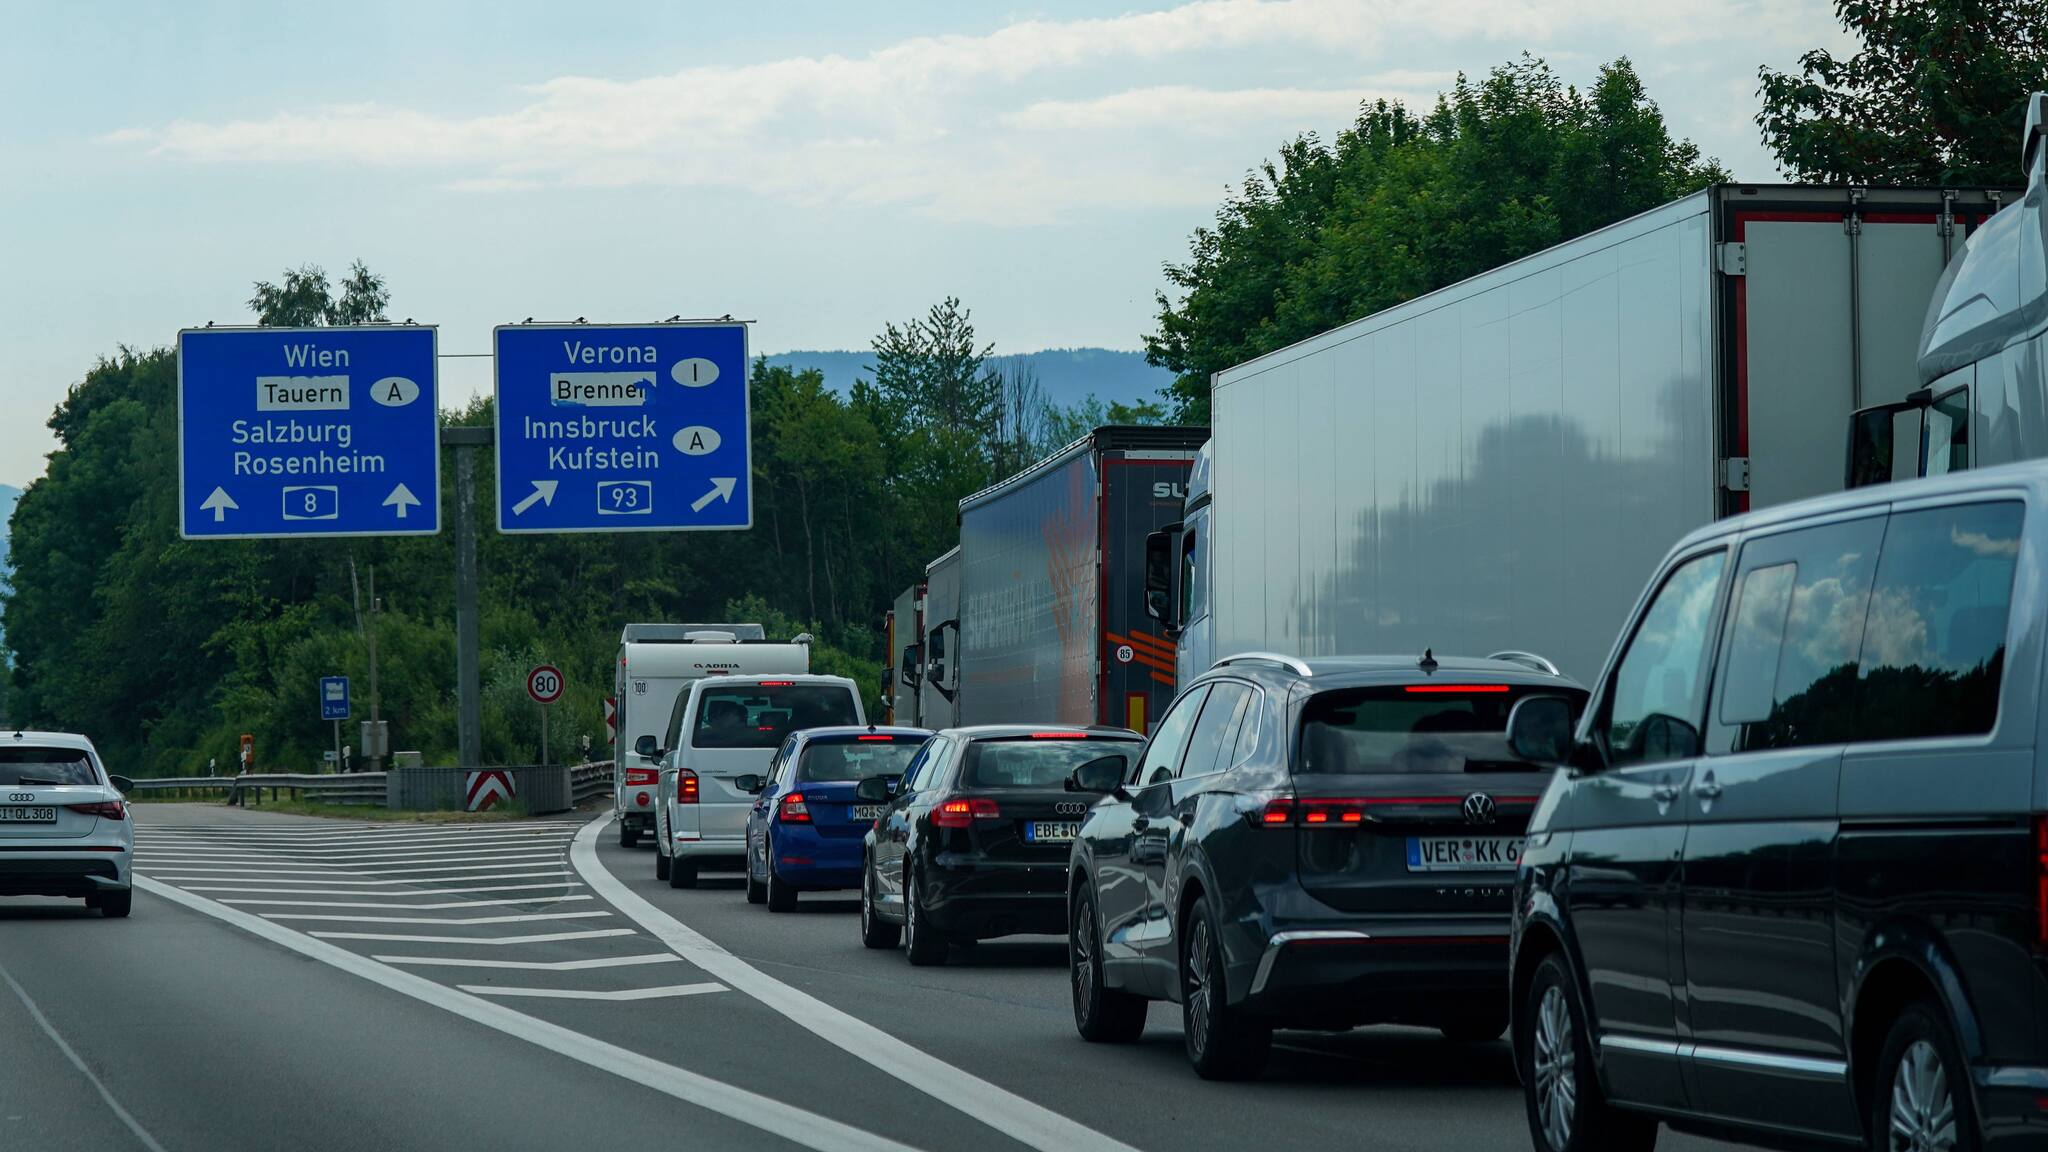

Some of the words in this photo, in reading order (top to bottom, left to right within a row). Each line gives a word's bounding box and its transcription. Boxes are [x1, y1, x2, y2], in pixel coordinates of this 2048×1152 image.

[283, 344, 349, 367] Wien
[564, 341, 657, 364] Verona
[692, 363, 698, 382] I
[264, 383, 342, 403] Tauern
[387, 382, 403, 401] A
[231, 419, 351, 448] Salzburg
[524, 414, 657, 439] Innsbruck
[688, 431, 705, 450] A
[233, 450, 385, 475] Rosenheim
[549, 446, 660, 469] Kufstein
[303, 493, 317, 512] 8
[611, 488, 638, 507] 93
[1119, 648, 1130, 659] 85
[535, 676, 556, 693] 80
[634, 682, 646, 693] 100
[325, 706, 330, 715] 2
[333, 704, 347, 714] km
[15, 808, 31, 819] QL
[32, 808, 54, 819] 308
[854, 806, 869, 818] MQ
[1034, 823, 1061, 838] EBE
[1421, 840, 1461, 863] VER
[1475, 840, 1502, 863] KK
